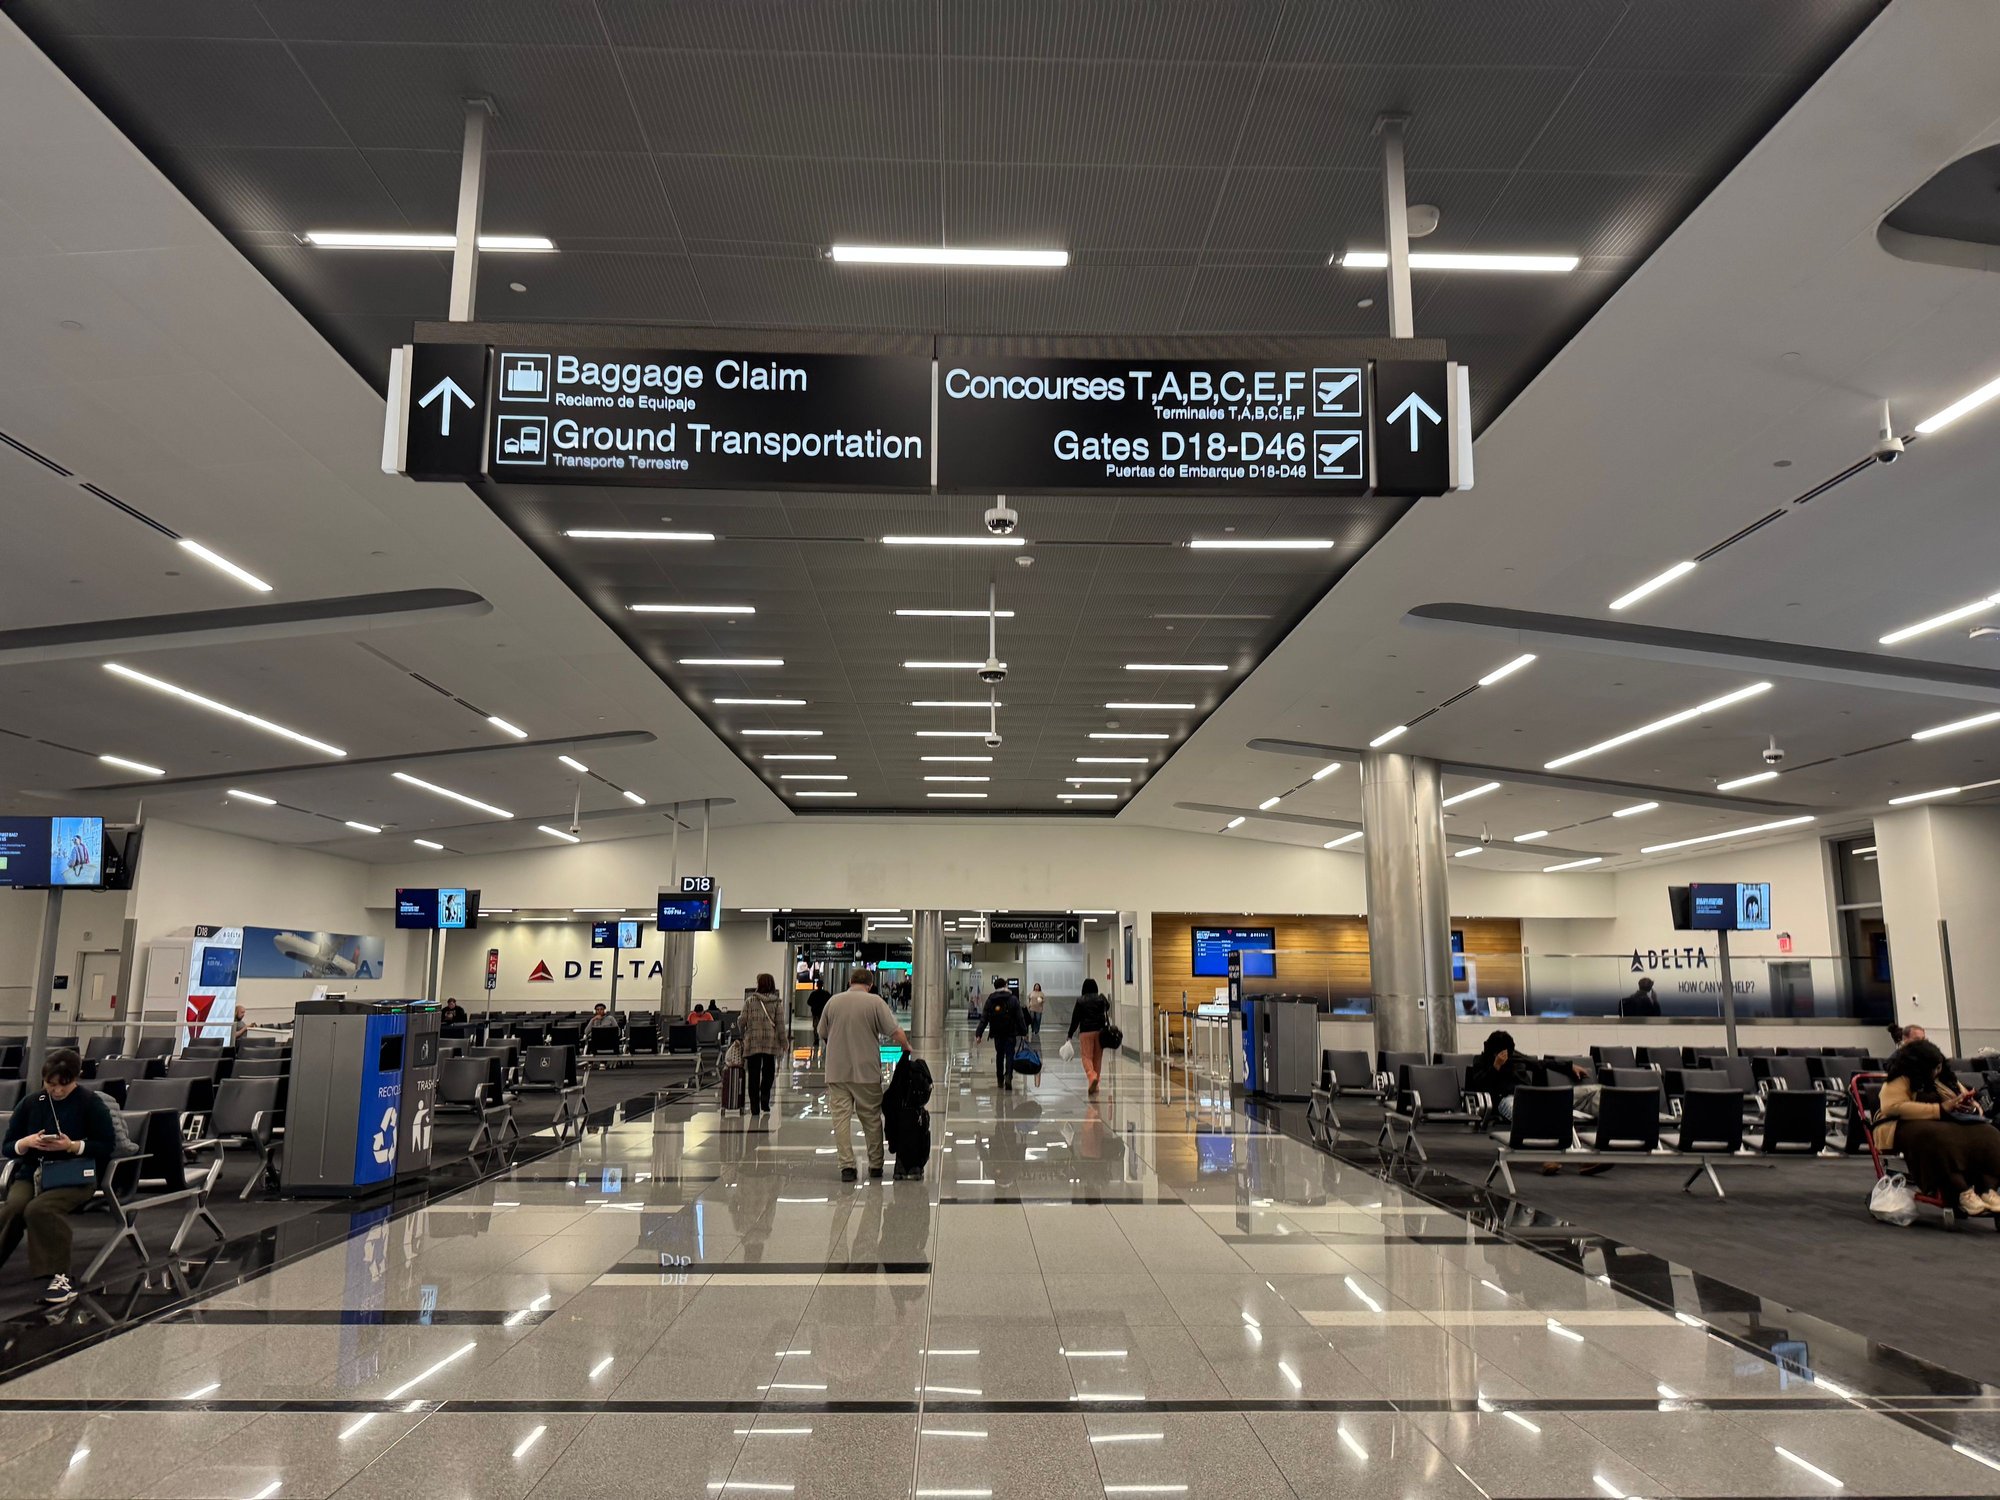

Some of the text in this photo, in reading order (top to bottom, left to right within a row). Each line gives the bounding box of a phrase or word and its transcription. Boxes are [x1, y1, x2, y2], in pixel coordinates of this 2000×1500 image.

[556, 355, 808, 395] Baggage Claim
[945, 368, 1306, 406] Concourses T,A,B,C,E,F
[555, 393, 696, 412] Reclamo de Equipaje
[1153, 405, 1305, 421] Terminales T,A,B,C,E,F
[552, 419, 923, 462] Ground Transportation
[1053, 429, 1306, 462] Gates D18-D46
[552, 453, 689, 471] Transporte Terrestre
[1106, 463, 1307, 481] Puertas de Embarque D18-D46
[683, 877, 710, 891] D18
[197, 926, 208, 937] D18
[992, 921, 1023, 929] Concourses
[820, 931, 862, 939] Transportation
[1647, 946, 1708, 969] DELTA
[1678, 981, 1698, 993] HOW
[1699, 981, 1716, 993] CAN
[1731, 981, 1755, 993] HELP?
